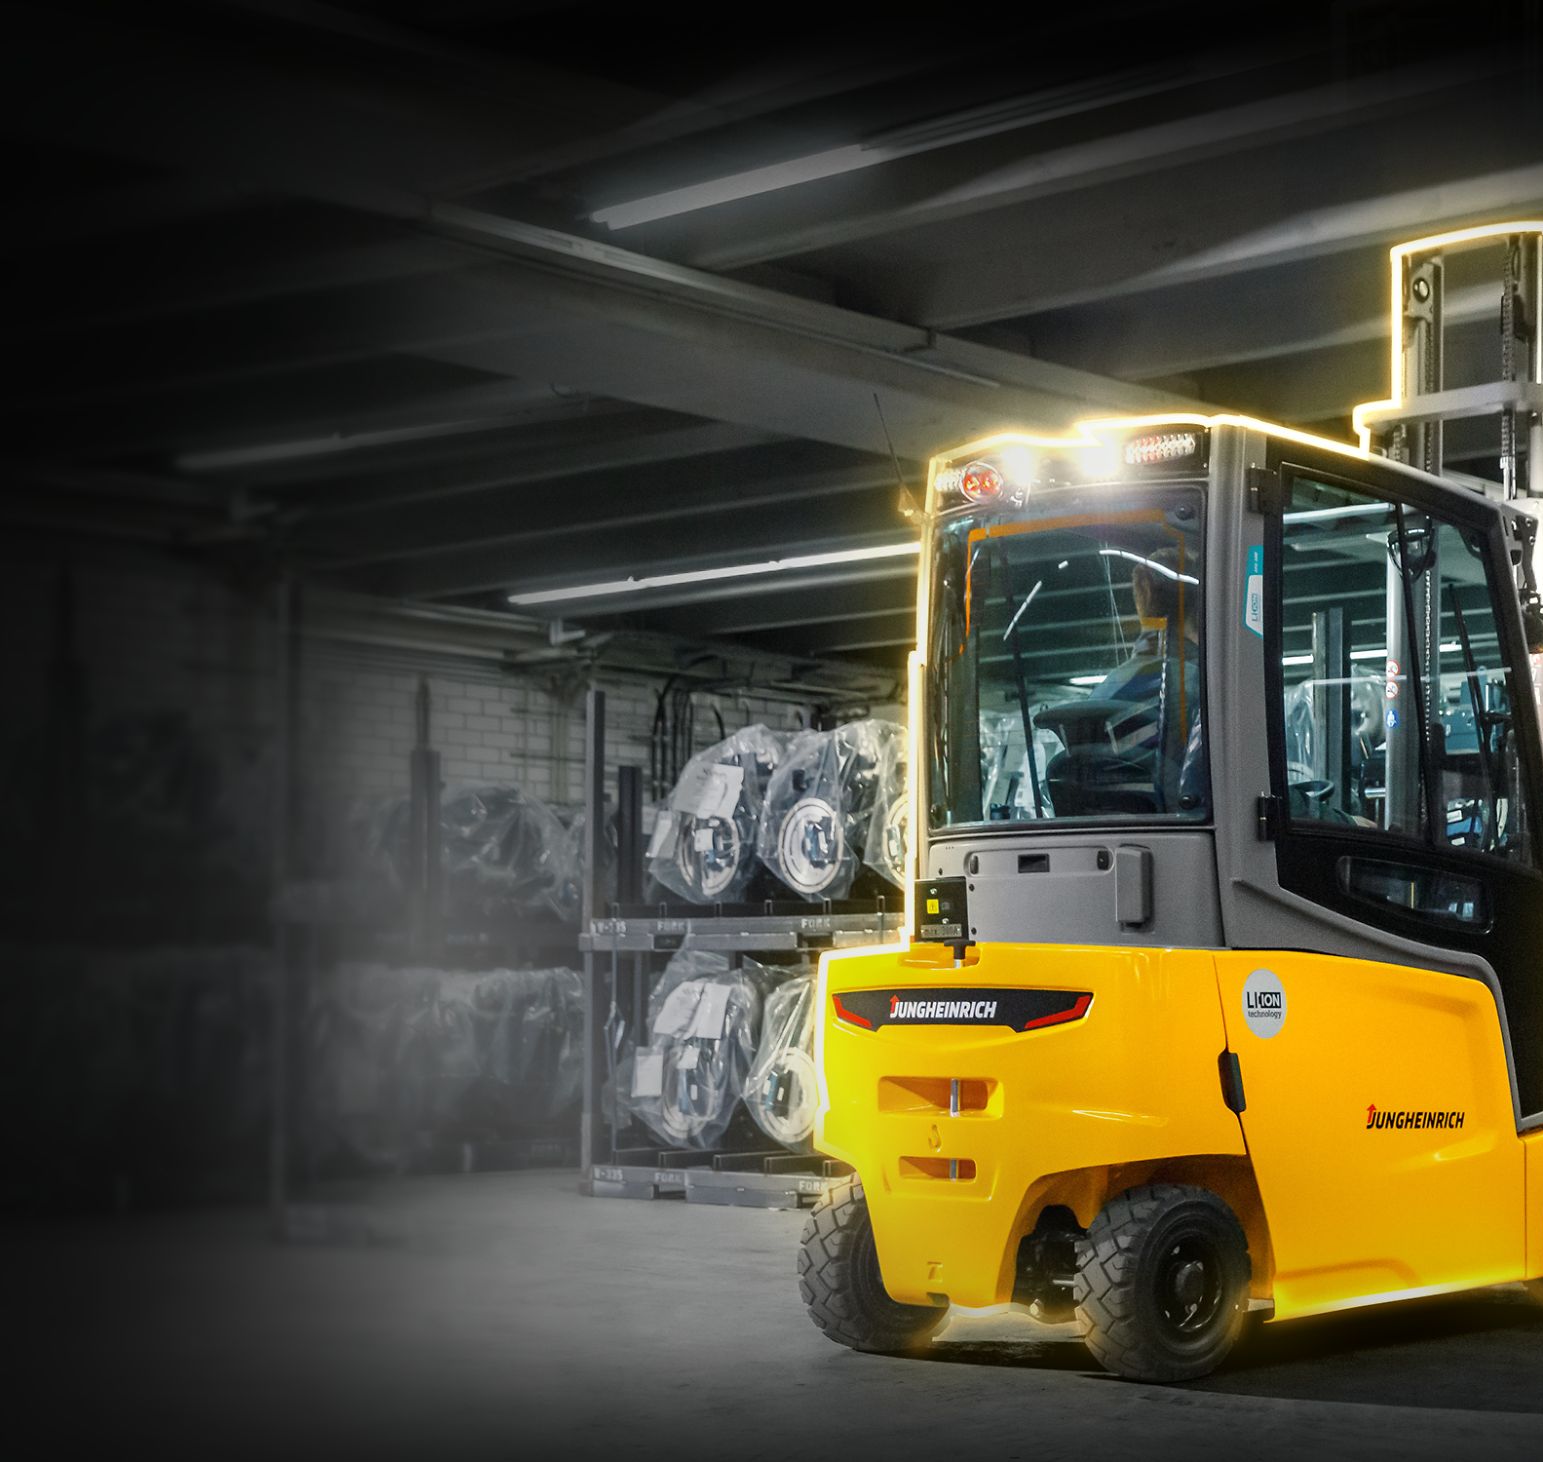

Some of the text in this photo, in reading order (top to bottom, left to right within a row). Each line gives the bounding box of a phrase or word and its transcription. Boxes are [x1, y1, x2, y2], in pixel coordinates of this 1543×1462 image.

[801, 917, 831, 929] FORK
[889, 999, 998, 1019] JUNGHEINRICH
[1248, 1010, 1282, 1019] technology
[1366, 1108, 1466, 1129] JUNGHEINRICH
